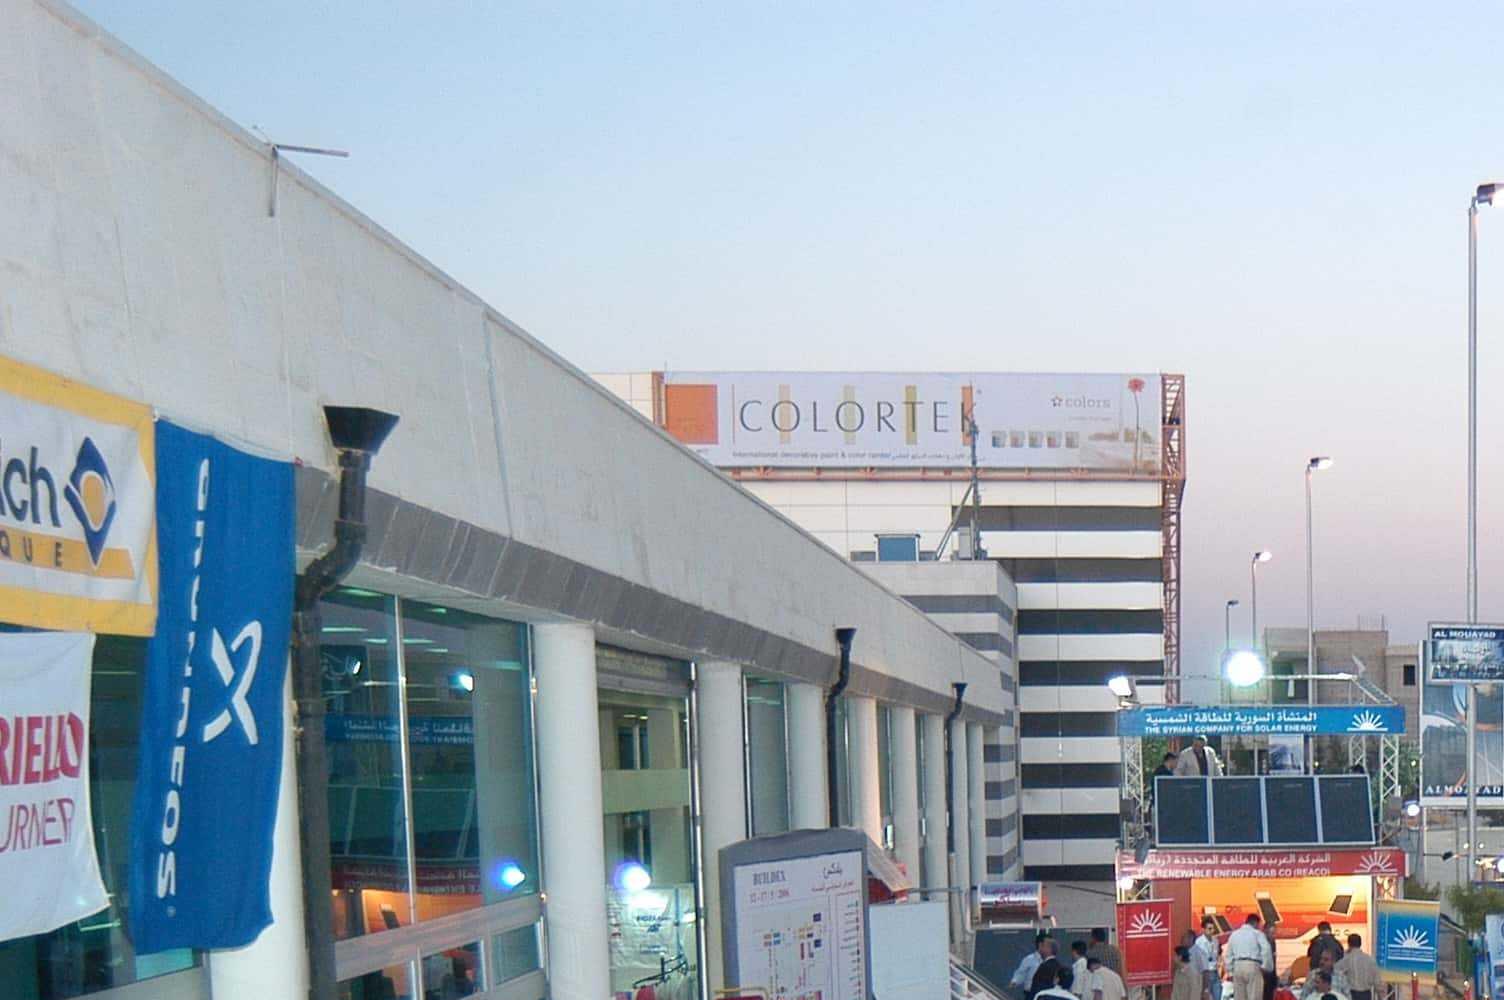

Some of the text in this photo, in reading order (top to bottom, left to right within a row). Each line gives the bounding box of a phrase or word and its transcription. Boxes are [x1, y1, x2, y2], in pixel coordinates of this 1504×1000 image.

[1065, 395, 1110, 408] colors
[732, 451, 777, 459] International
[781, 451, 818, 459] decorative
[820, 451, 838, 461] paint
[0, 446, 61, 528] ch
[1146, 712, 1317, 727] المنشأة السورية للطاقة الشمسية
[1145, 724, 1317, 734] THE SYRIAN COMPANY FOR SOLAR ENERGY
[1174, 855, 1218, 866] المتجددة
[1221, 855, 1257, 865] للطاقة
[1261, 855, 1295, 866] العربية
[1298, 854, 1330, 865] الشركة
[753, 870, 786, 886] BUILDEX
[1155, 868, 1211, 878] RENEWABLE
[1214, 868, 1250, 878] ENERGY
[1252, 868, 1276, 877] ARAB
[1279, 868, 1291, 876] CO
[1293, 867, 1331, 877] (REACO)
